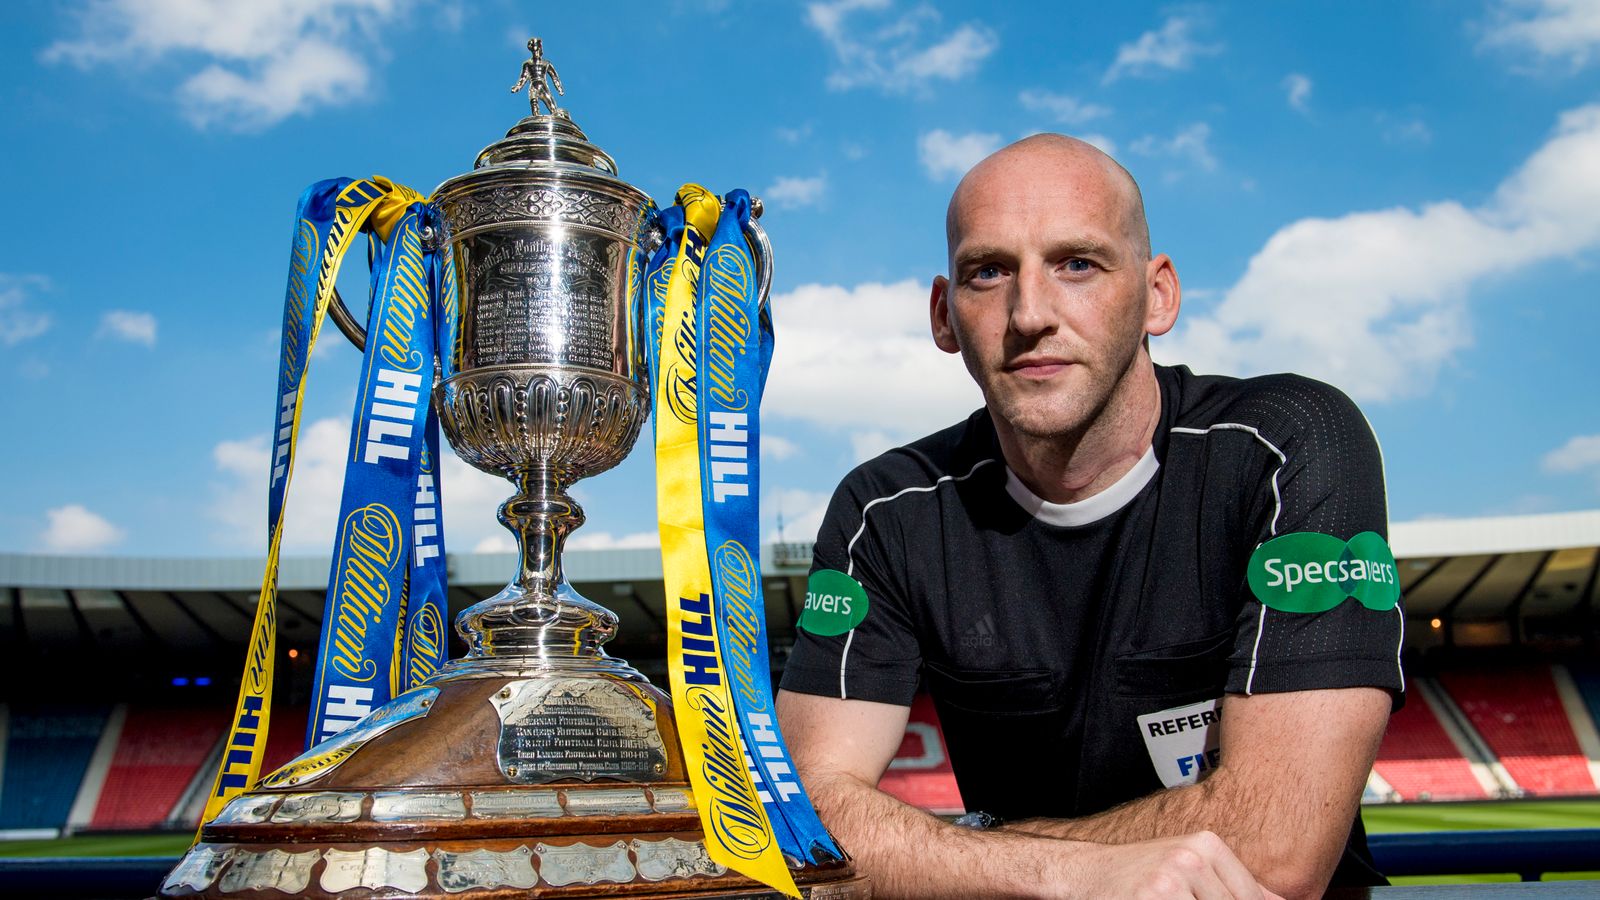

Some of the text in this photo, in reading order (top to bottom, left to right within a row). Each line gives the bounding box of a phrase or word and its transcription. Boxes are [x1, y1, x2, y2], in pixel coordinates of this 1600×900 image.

[364, 368, 423, 465] HILL
[709, 243, 755, 504] William HILL
[271, 391, 297, 489] HILL
[414, 474, 440, 568] HILL
[332, 503, 403, 682] William
[804, 591, 852, 615] avers
[1264, 558, 1394, 593] Specsavers
[680, 592, 721, 687] HILL
[714, 539, 766, 711] William
[747, 712, 801, 802] HILL
[217, 695, 263, 797] HILL
[1147, 707, 1222, 737] REFER
[685, 686, 771, 860] William
